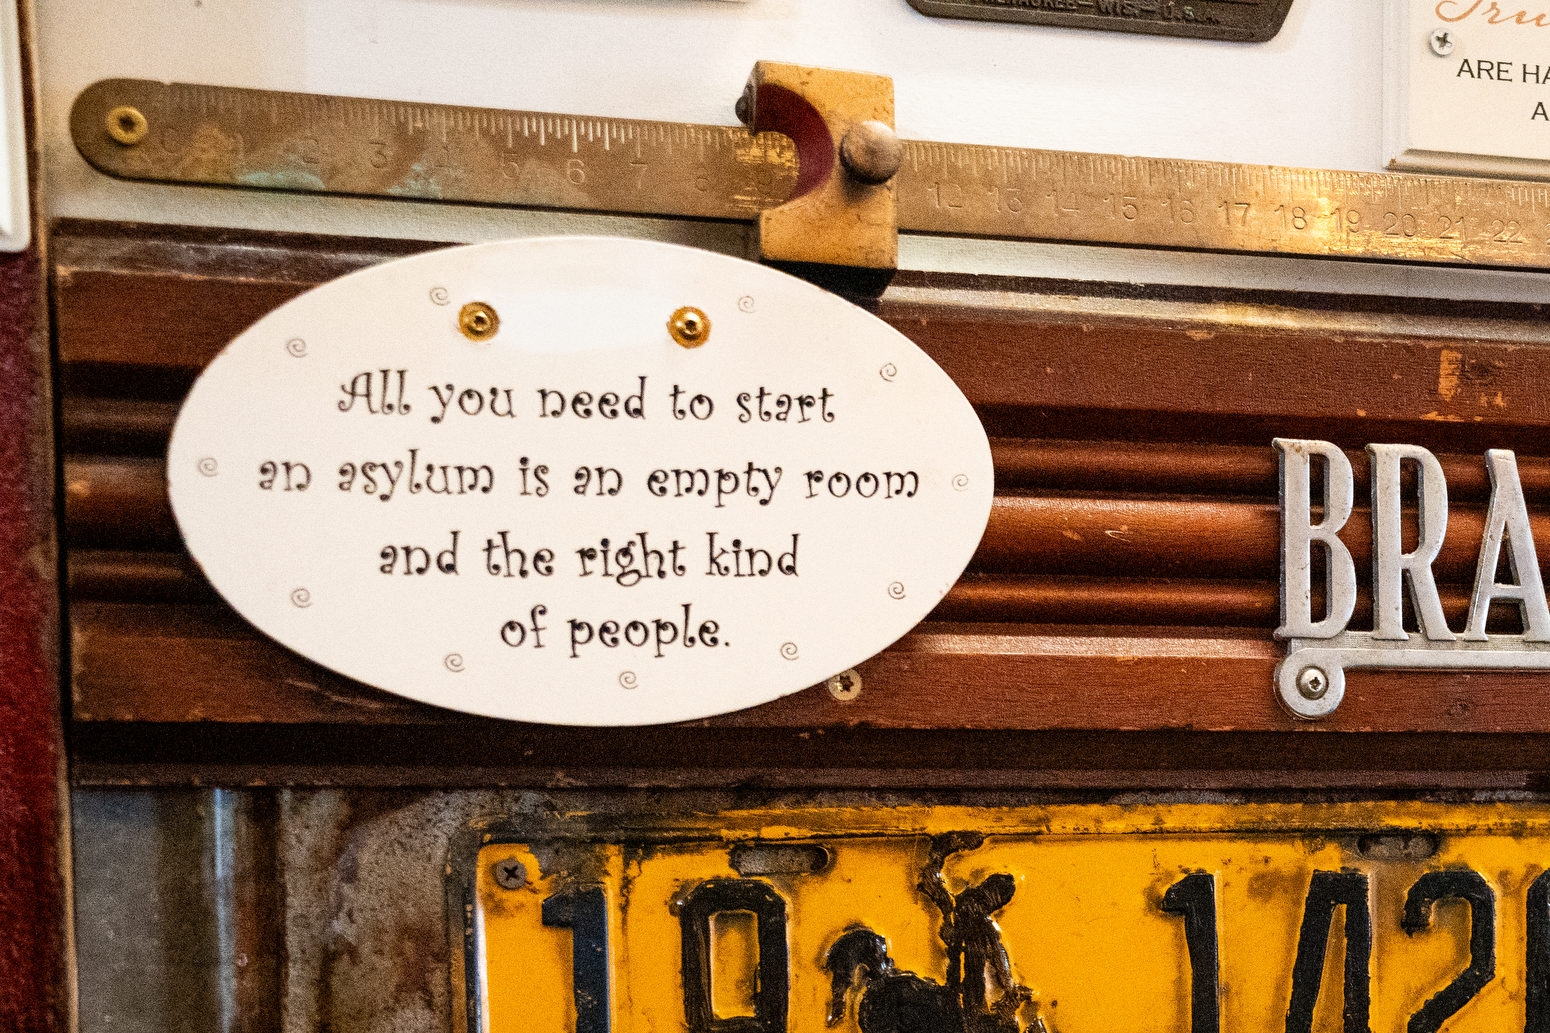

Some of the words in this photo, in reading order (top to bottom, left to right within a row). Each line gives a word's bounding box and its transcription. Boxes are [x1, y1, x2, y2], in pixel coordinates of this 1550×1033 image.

[1456, 58, 1513, 83] ARE
[566, 158, 586, 185] 6
[629, 161, 649, 190] 7
[1218, 199, 1251, 227] 17
[1275, 203, 1307, 231] 18
[1330, 206, 1363, 234] 19
[1383, 210, 1418, 238] 20
[1437, 214, 1467, 242] 21
[1491, 219, 1523, 245] 22
[337, 368, 411, 416] All
[427, 383, 517, 425] you
[538, 375, 647, 422] need
[669, 383, 715, 422] to
[736, 385, 836, 425] start
[258, 459, 312, 492] an
[338, 448, 495, 502] asylum
[519, 456, 550, 498] is
[573, 464, 624, 498] an
[646, 460, 783, 508] empty
[804, 466, 920, 500] room
[379, 530, 461, 577] and
[482, 530, 555, 579] the
[575, 531, 687, 587] right
[704, 531, 800, 579] kind
[500, 603, 548, 650] of
[566, 602, 731, 659] people.
